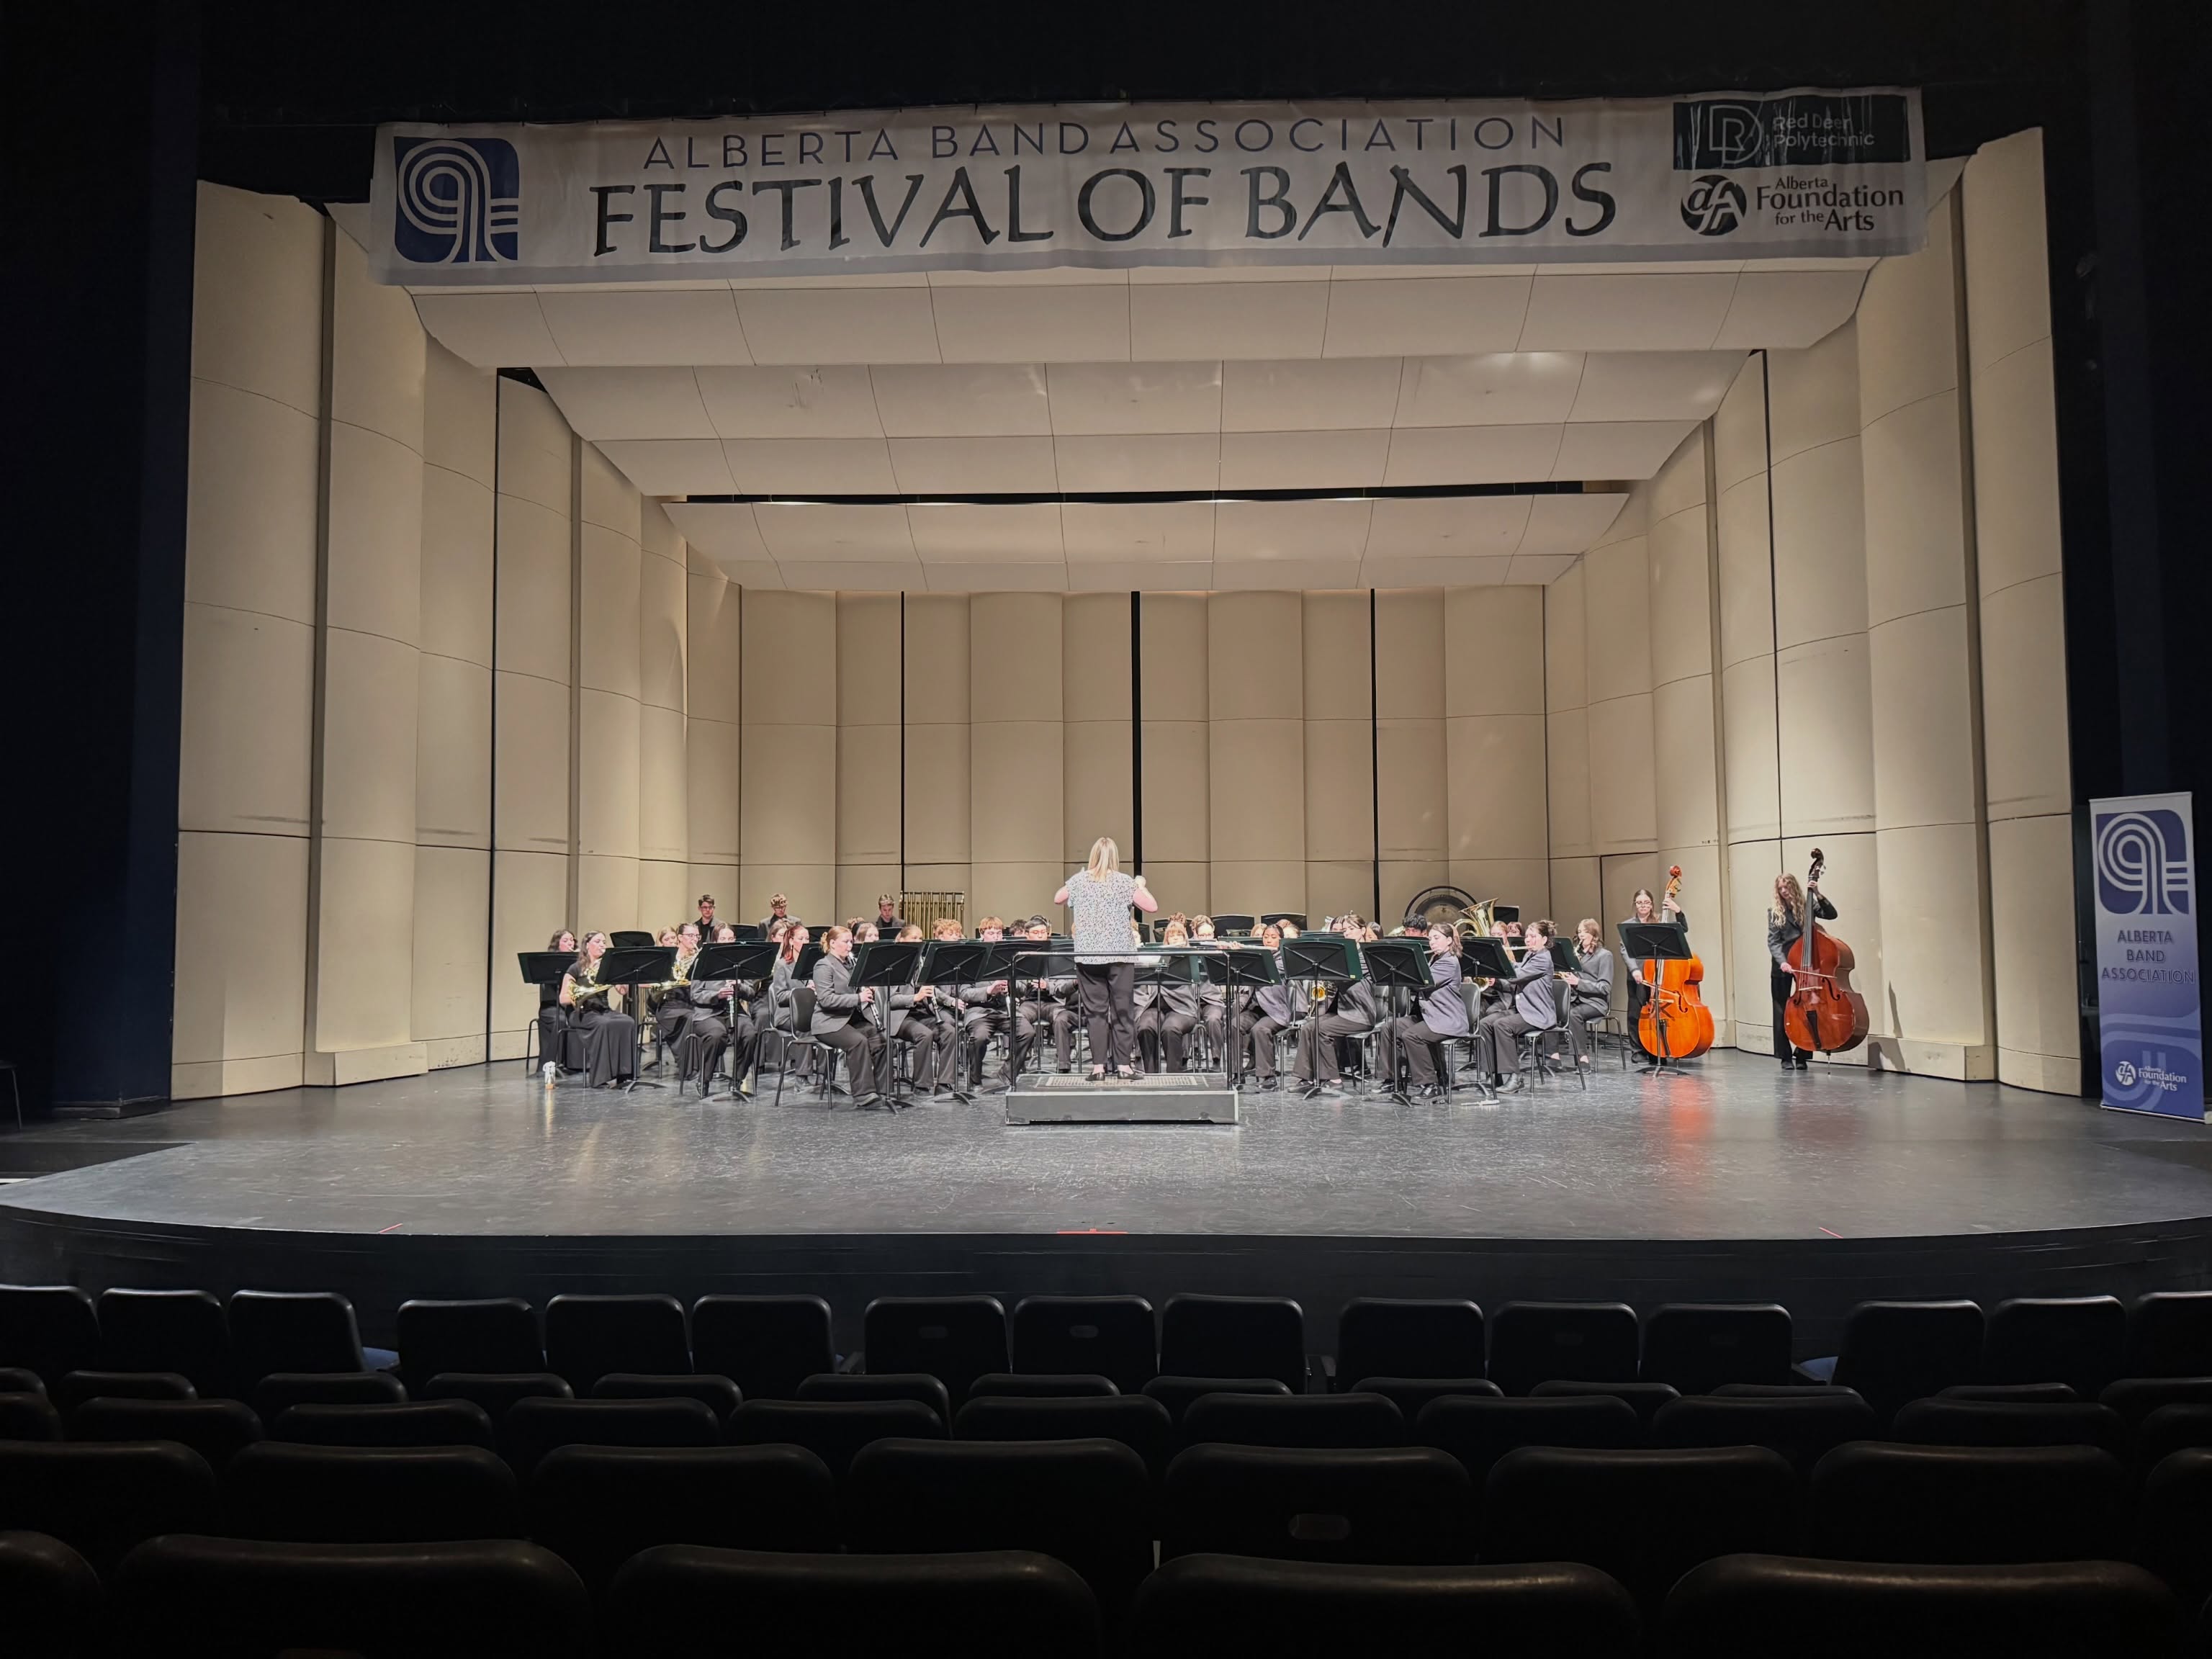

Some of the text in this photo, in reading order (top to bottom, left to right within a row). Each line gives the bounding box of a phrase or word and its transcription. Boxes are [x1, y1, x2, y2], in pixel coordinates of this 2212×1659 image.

[1773, 112, 1852, 130] Red Deer
[644, 116, 1563, 170] ALBERTA BAND ASSOCIATION
[1773, 131, 1875, 150] Polytechnic
[1775, 176, 1829, 190] Alberta
[1756, 184, 1905, 211] Foundation
[588, 161, 1617, 258] FESTIVAL OF BANDS
[1775, 208, 1875, 232] for the Arts
[2117, 930, 2173, 944] ALBERTA
[2126, 948, 2166, 963] BAND
[2101, 967, 2195, 984] ASSOCIATION
[2138, 1068, 2187, 1083] Foundation
[2160, 1080, 2177, 1091] Arts
